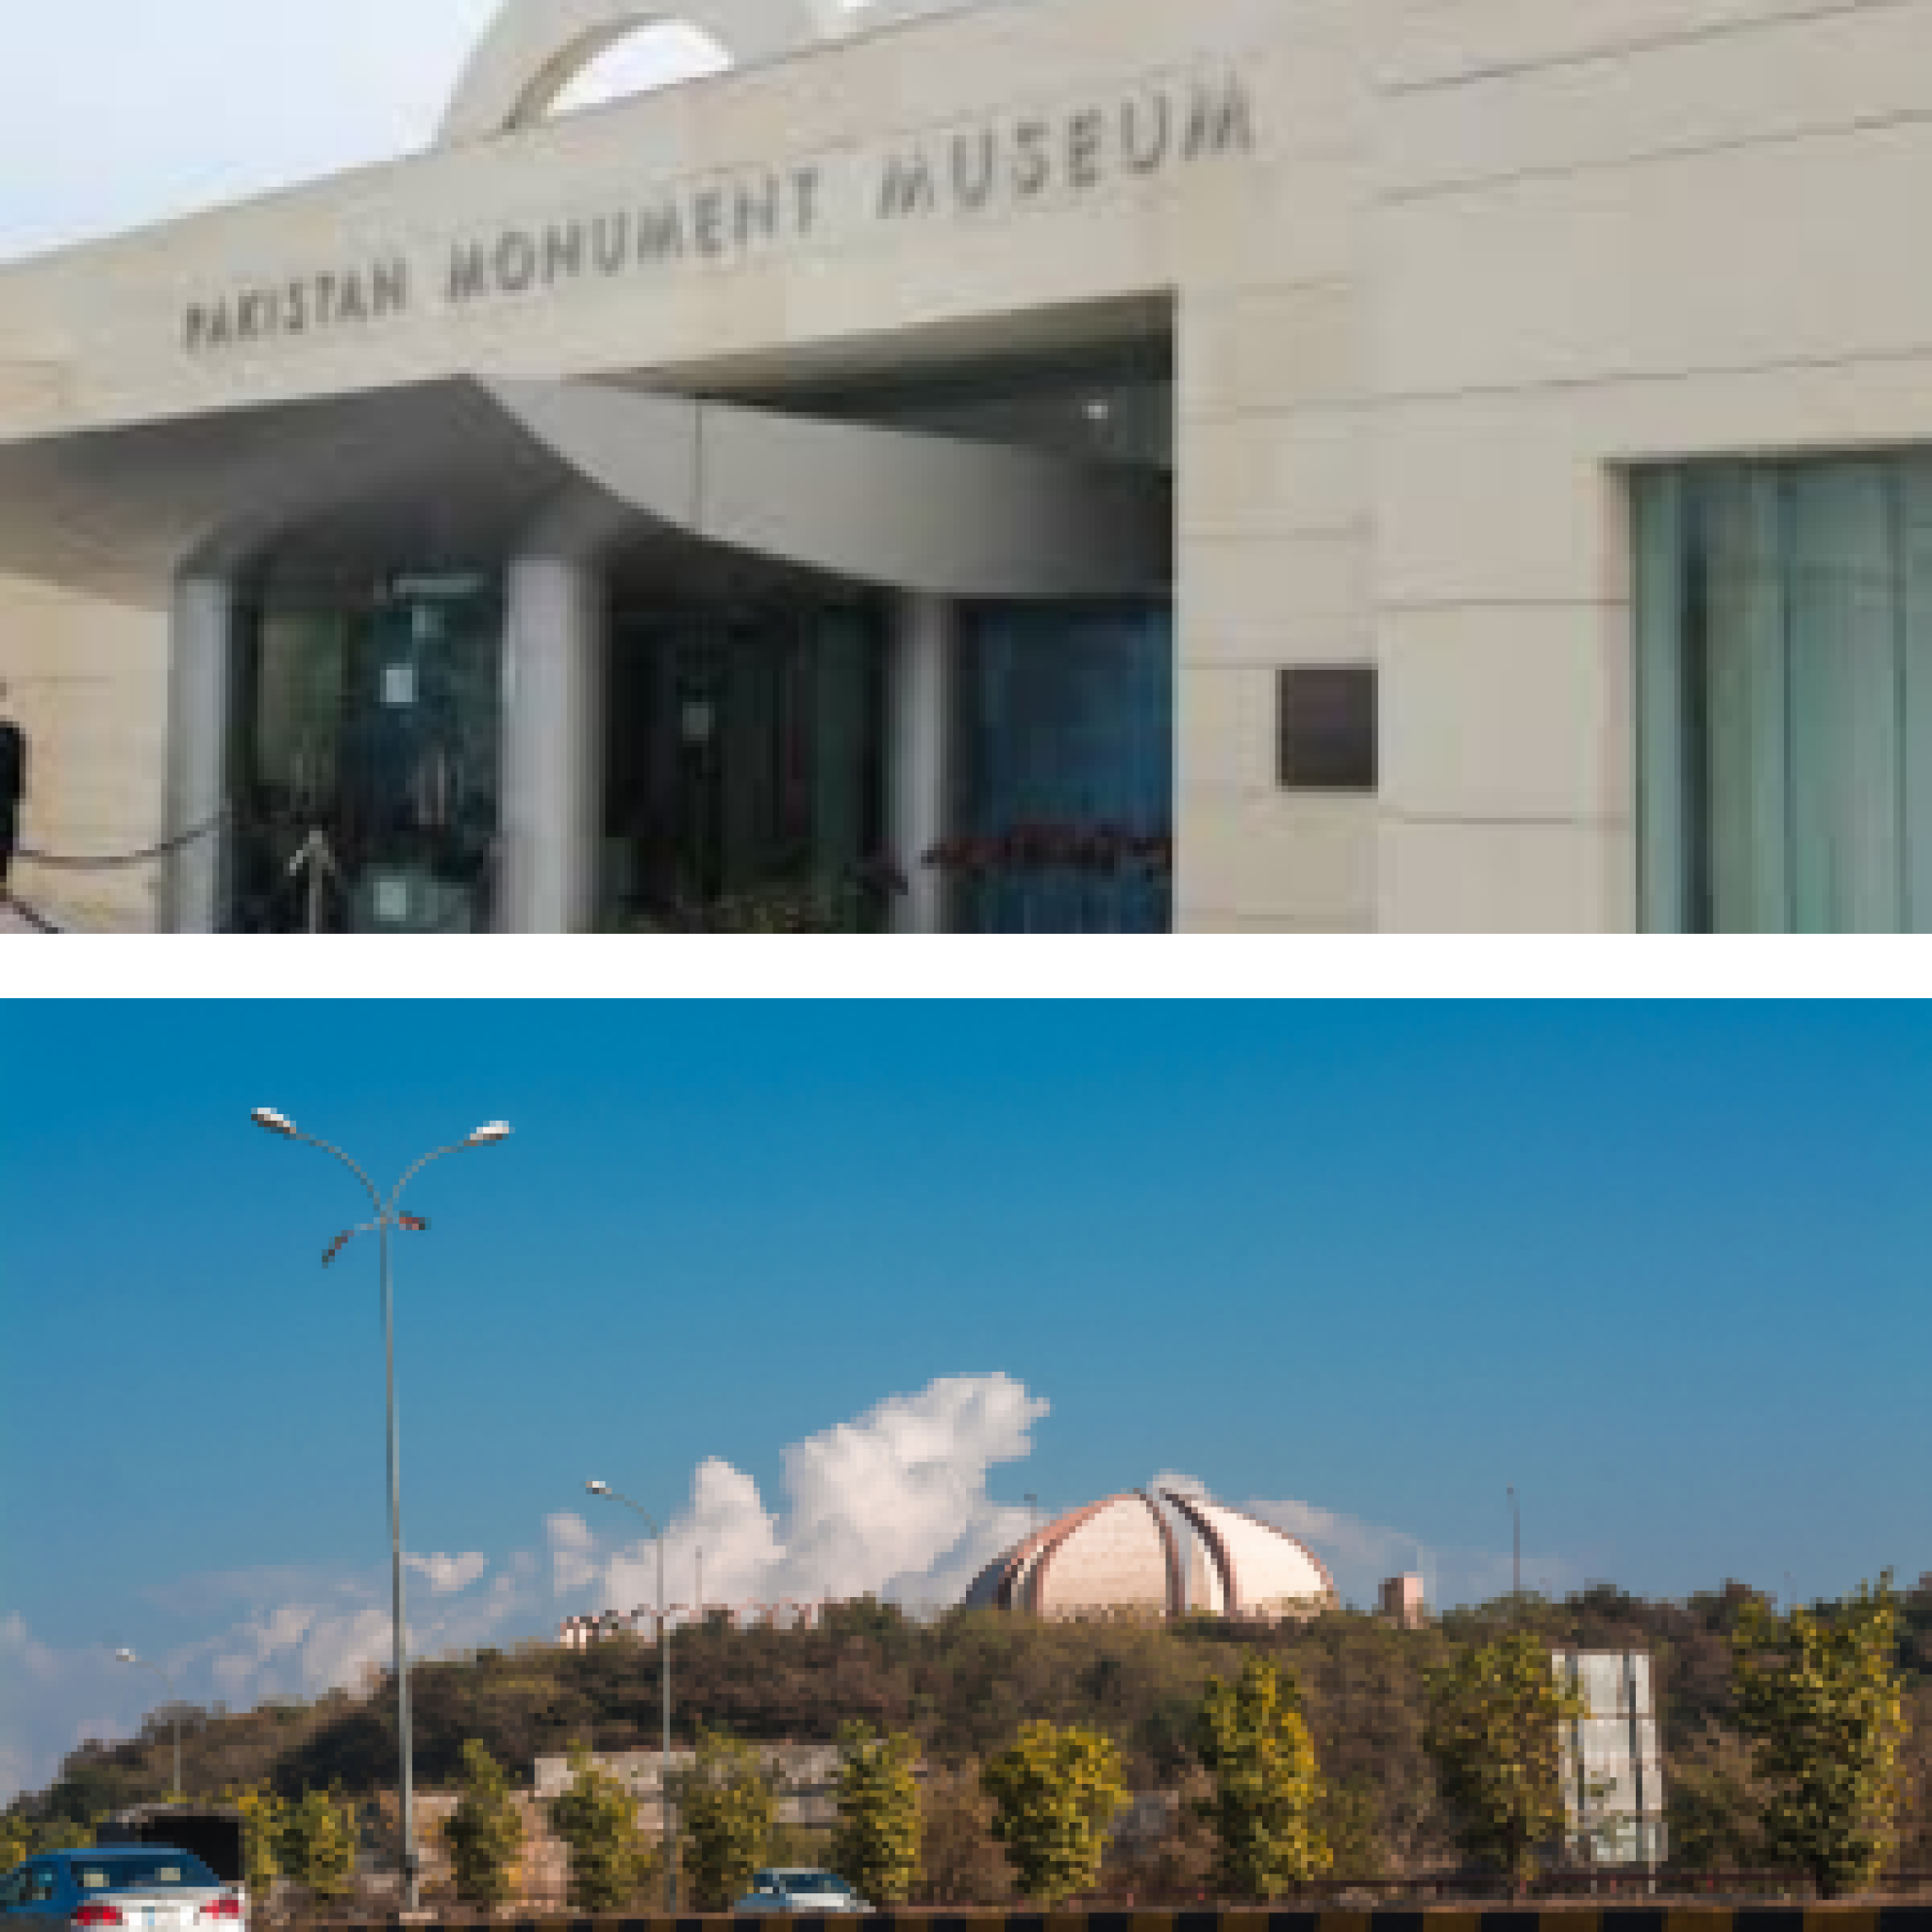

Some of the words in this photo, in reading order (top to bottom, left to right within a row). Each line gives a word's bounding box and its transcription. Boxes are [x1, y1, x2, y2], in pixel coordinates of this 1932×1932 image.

[185, 258, 406, 353] PAKISTAN
[450, 167, 818, 302] MONUMENT
[876, 74, 1256, 219] MUSEUM
